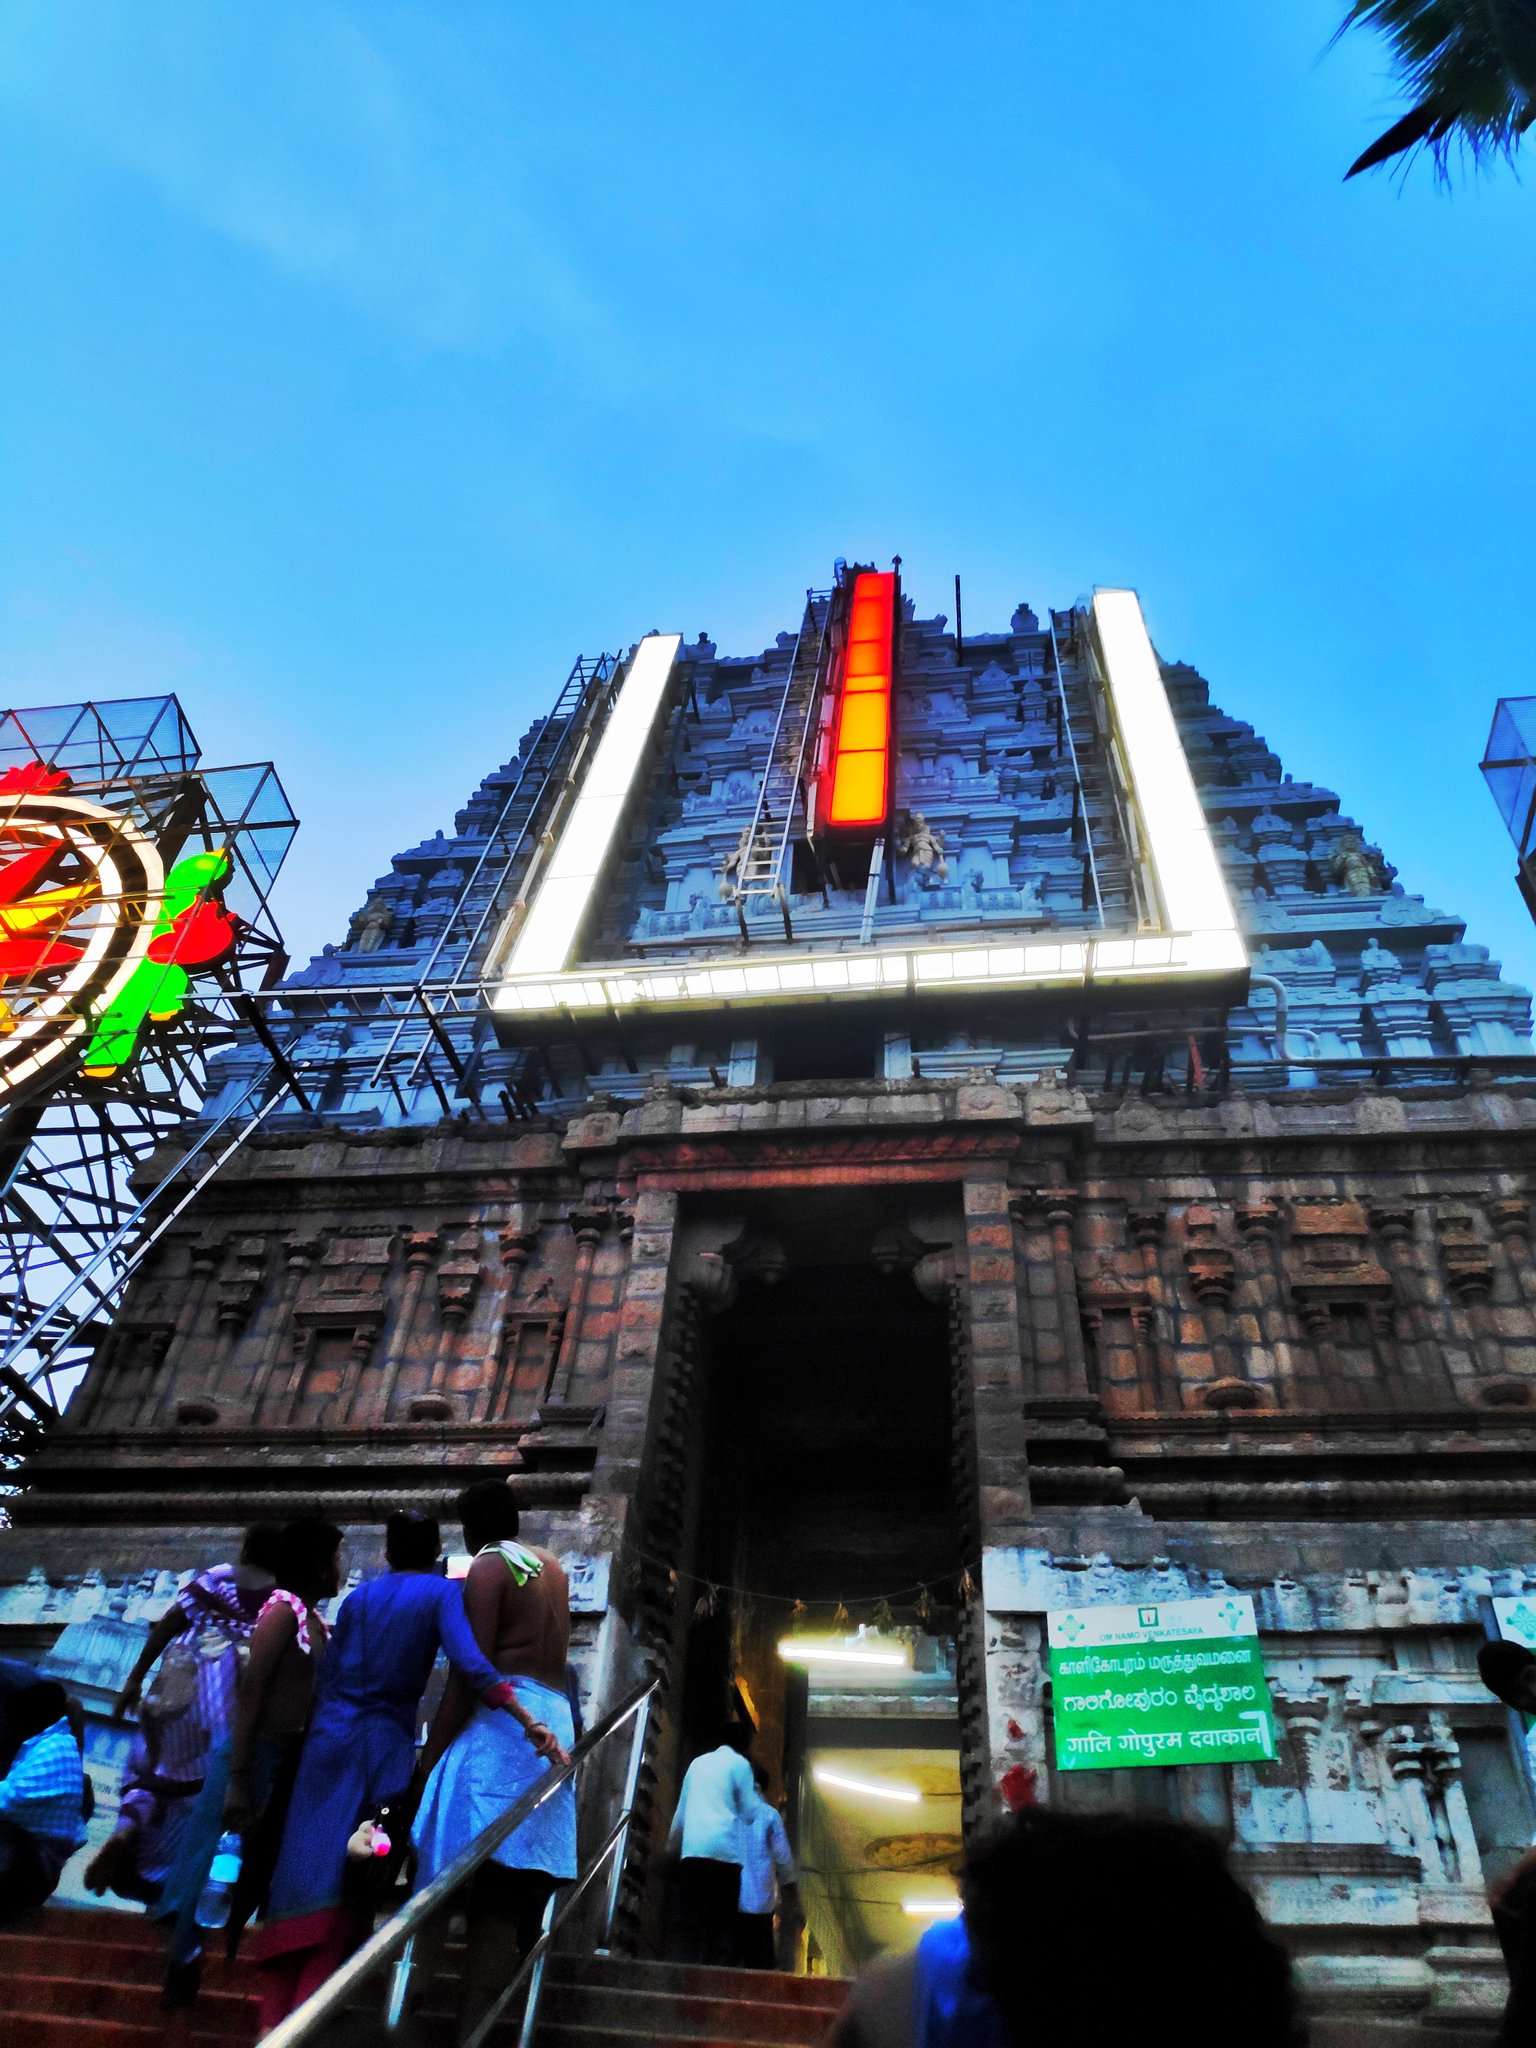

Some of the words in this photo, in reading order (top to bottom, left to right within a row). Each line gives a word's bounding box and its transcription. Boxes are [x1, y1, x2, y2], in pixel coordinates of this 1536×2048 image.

[1099, 1632, 1113, 1642] OM
[1115, 1630, 1140, 1641] NAMO
[1143, 1626, 1204, 1639] VENKATESAYA
[1148, 1648, 1251, 1674] மருத்துவமனை
[1066, 1730, 1112, 1754] गालि
[1117, 1728, 1183, 1758] गोपुरम
